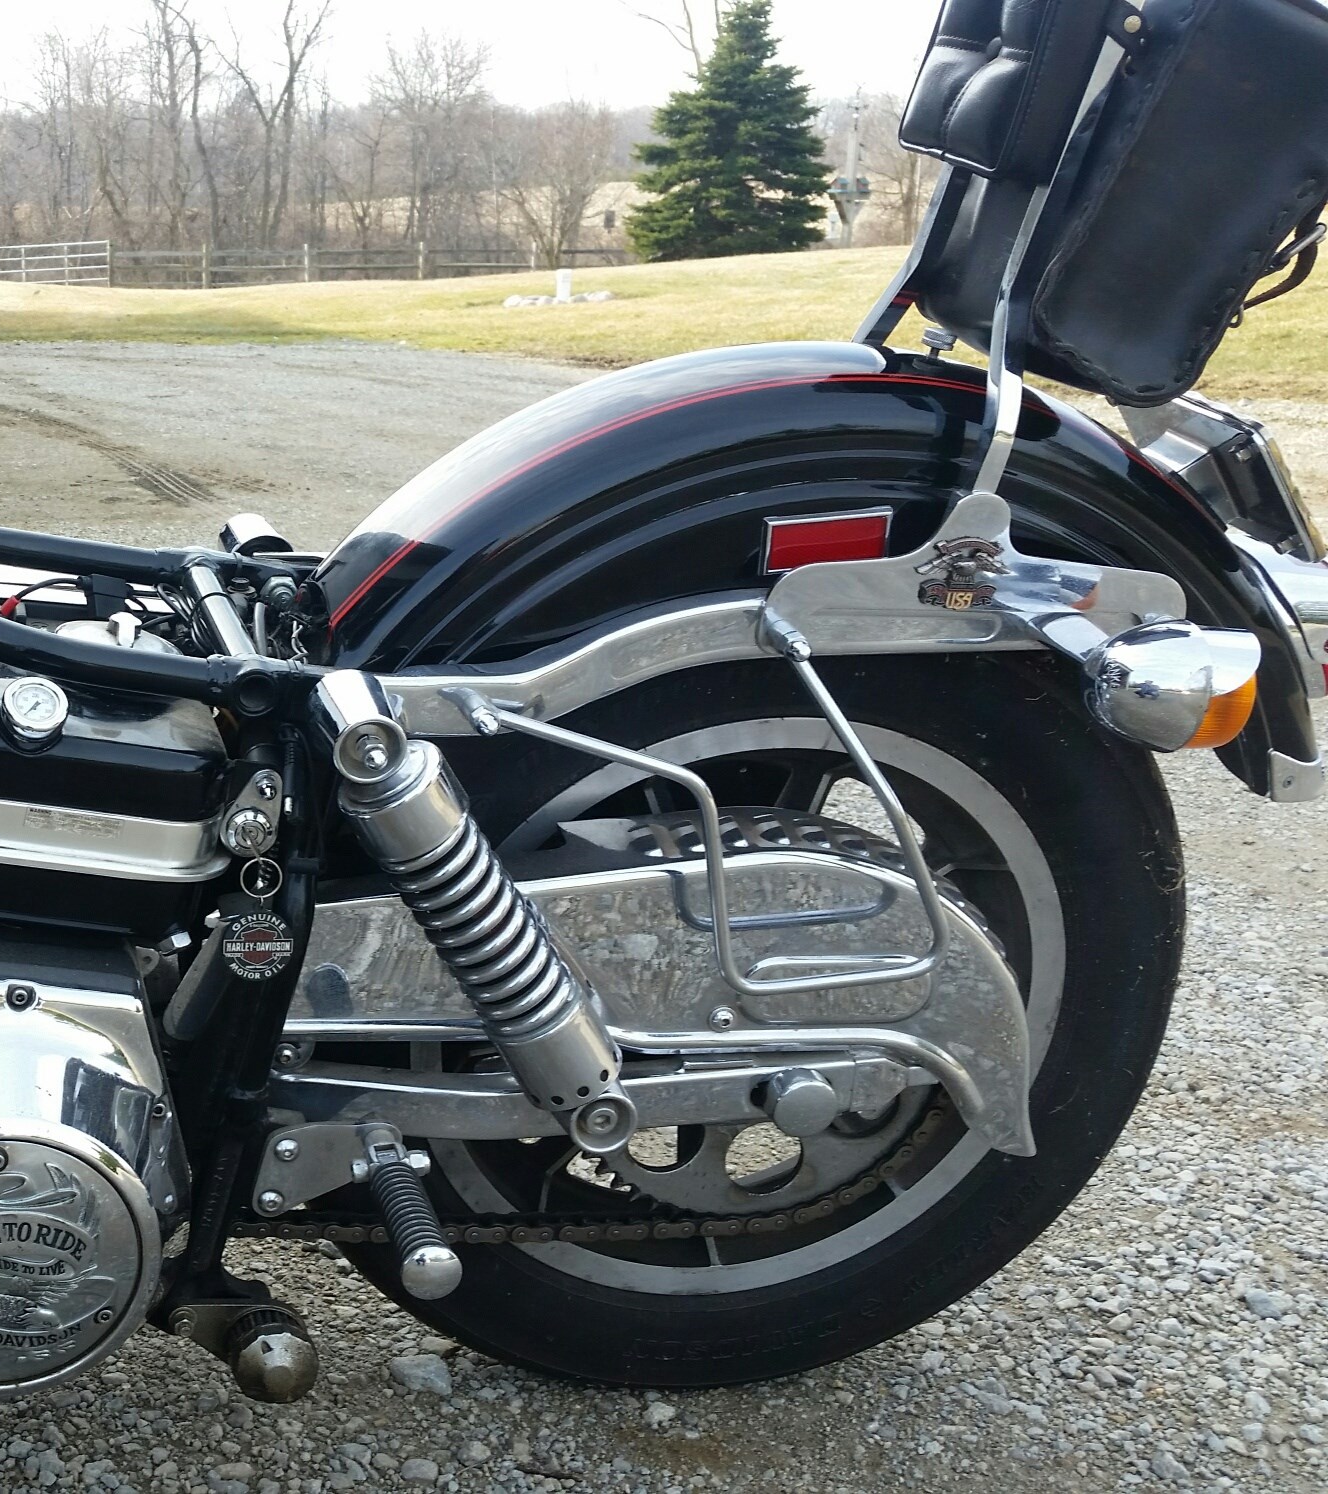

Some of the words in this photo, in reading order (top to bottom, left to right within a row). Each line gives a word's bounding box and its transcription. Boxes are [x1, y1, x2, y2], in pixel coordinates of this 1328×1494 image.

[945, 591, 974, 610] USA
[232, 913, 287, 931] GENUINE
[226, 942, 290, 952] HARLEY-DAVIDSON
[229, 962, 261, 979] MOTOR
[264, 963, 285, 977] OIL
[2, 1222, 31, 1243] TO
[34, 1223, 88, 1262] RIDE
[21, 1263, 35, 1275] TO
[38, 1259, 66, 1276] LIVE
